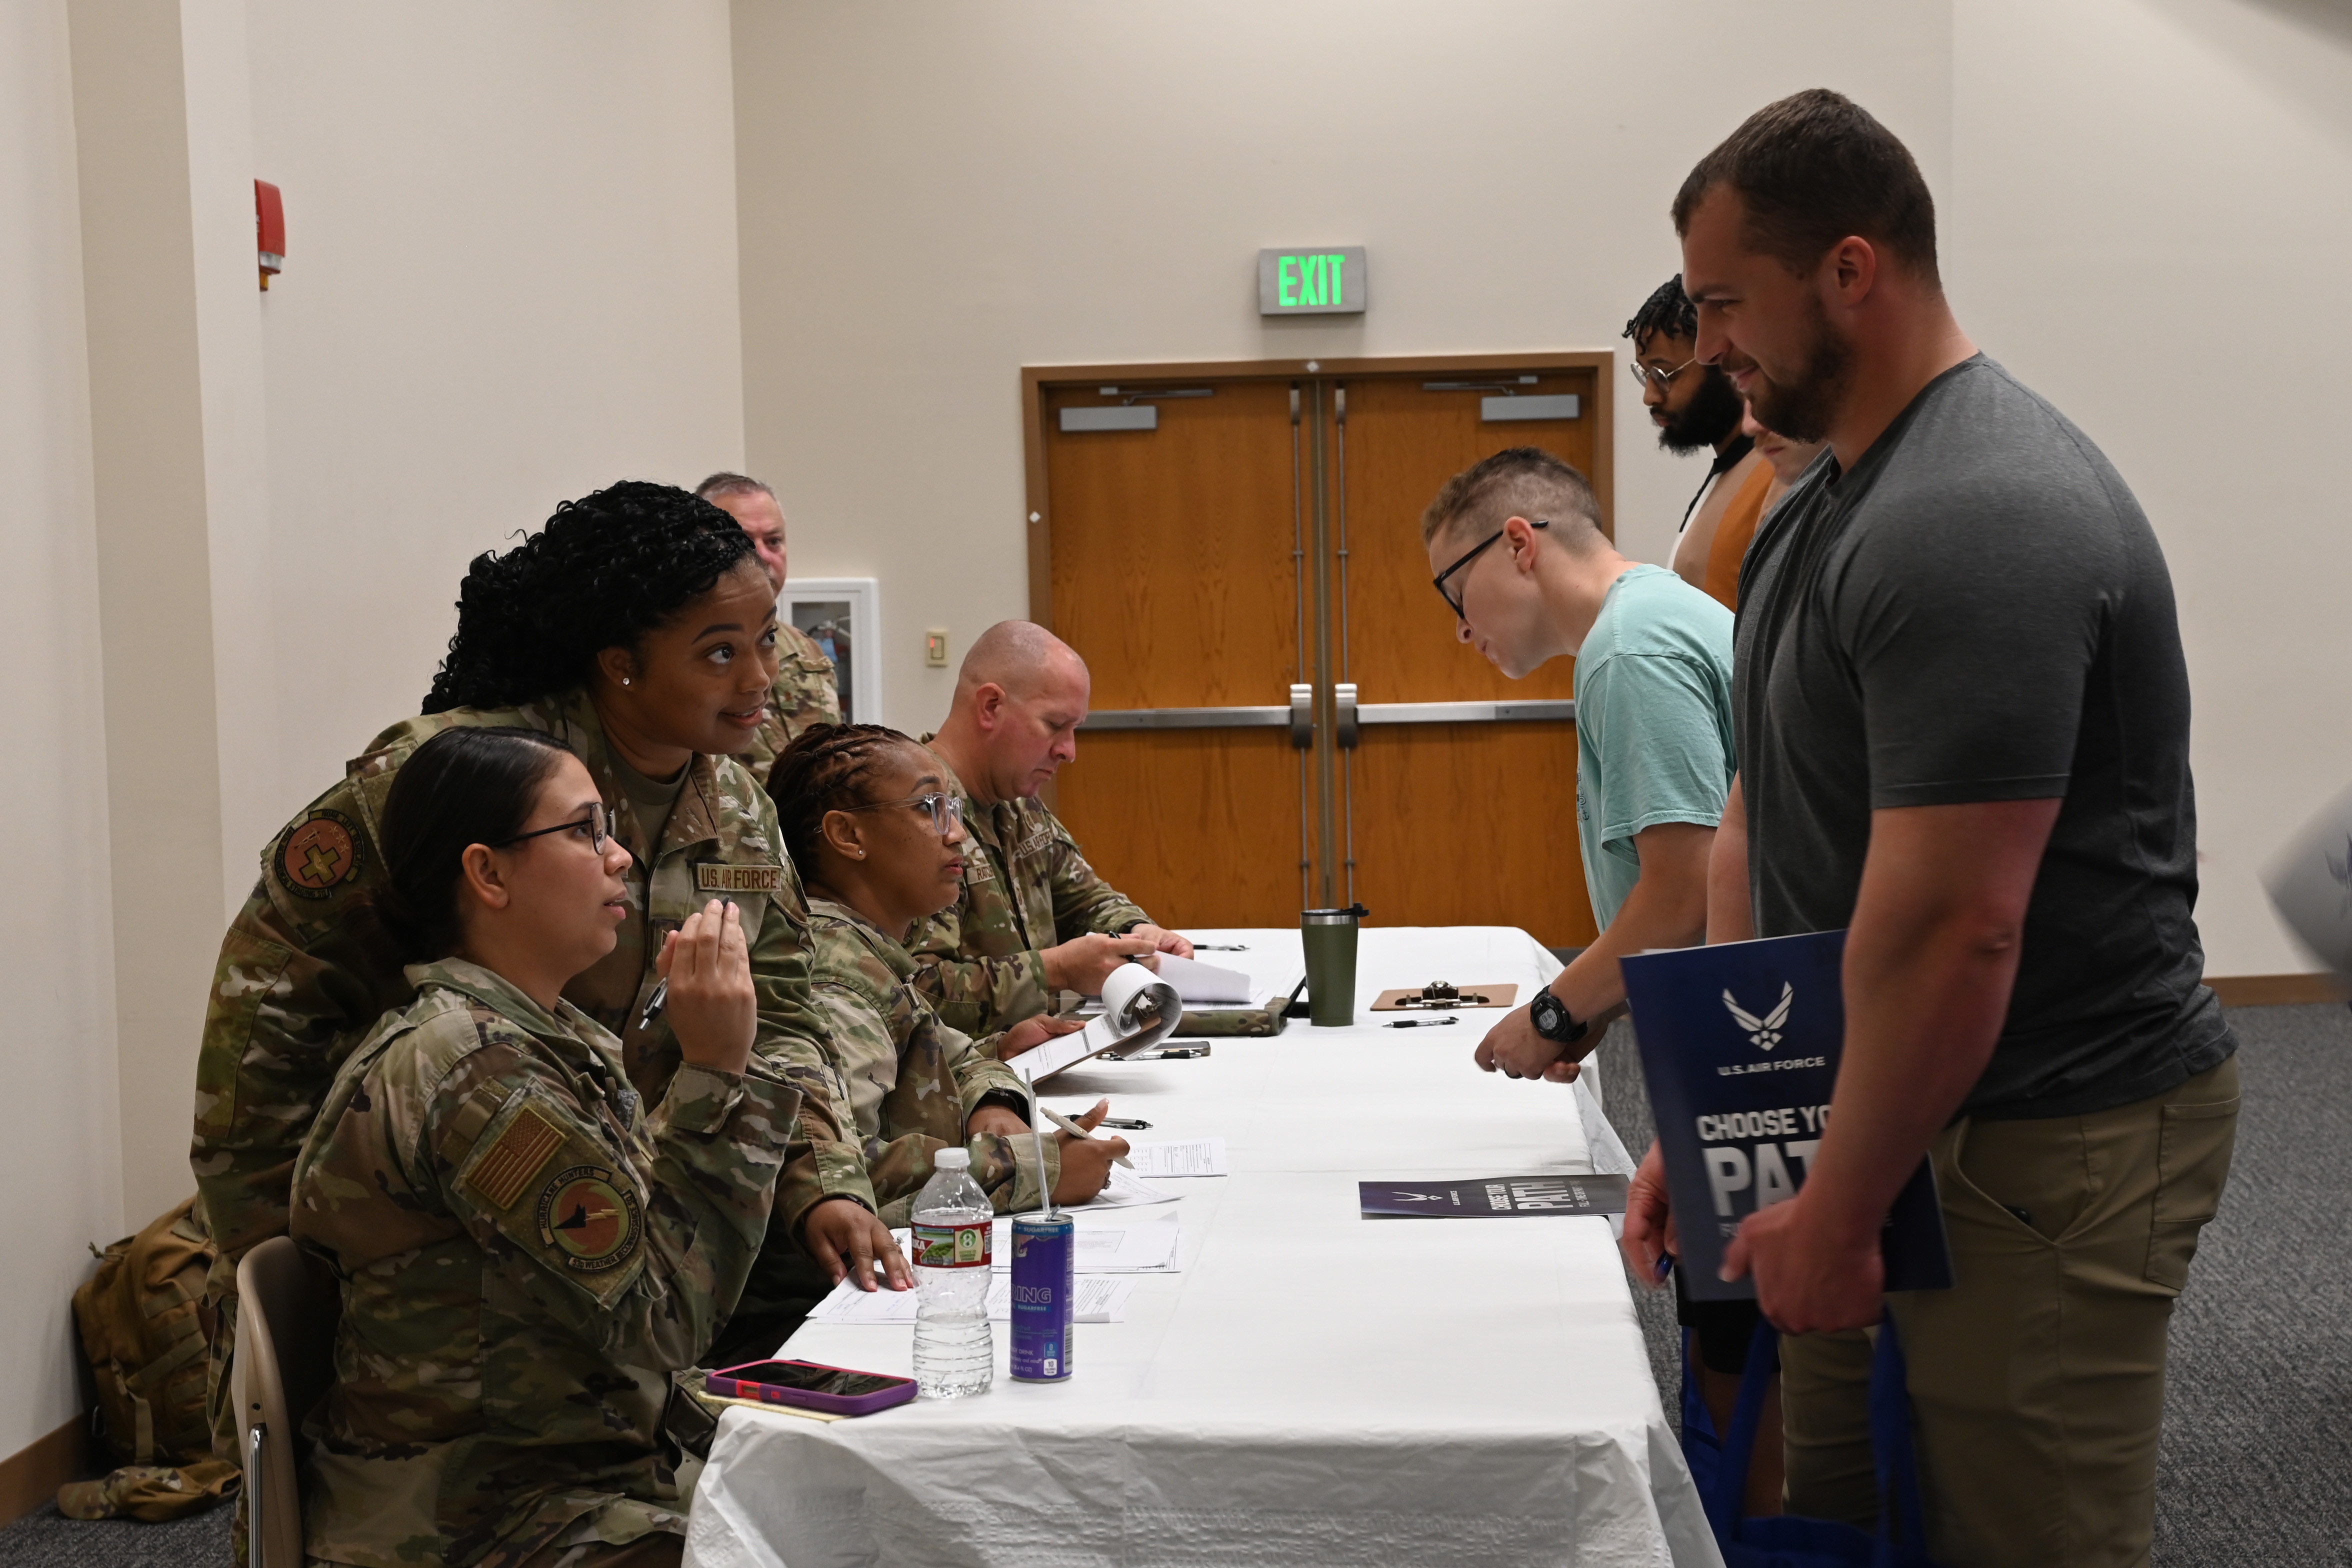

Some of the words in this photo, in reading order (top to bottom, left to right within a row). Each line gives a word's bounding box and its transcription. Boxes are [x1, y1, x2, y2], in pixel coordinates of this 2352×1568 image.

[1278, 254, 1346, 306] EXIT
[702, 868, 719, 888] U.S.
[722, 869, 732, 888] AIR
[734, 870, 777, 889] FORCE
[1717, 1064, 1745, 1076] U.S.
[1746, 1062, 1772, 1074] AIR
[1774, 1056, 1826, 1071] FORCE
[1696, 1108, 1798, 1141] CHOOSE
[1800, 1104, 1834, 1132] YO
[1702, 1139, 1823, 1216] PAT
[541, 1183, 558, 1228] HURRICANE
[559, 1169, 594, 1184] HUNTERS
[1485, 1184, 1507, 1194] YOUR
[1510, 1180, 1574, 1210] PATH
[1488, 1194, 1512, 1210] CHOOSE
[585, 1256, 616, 1268] WEATHER
[1011, 1286, 1052, 1304] RING
